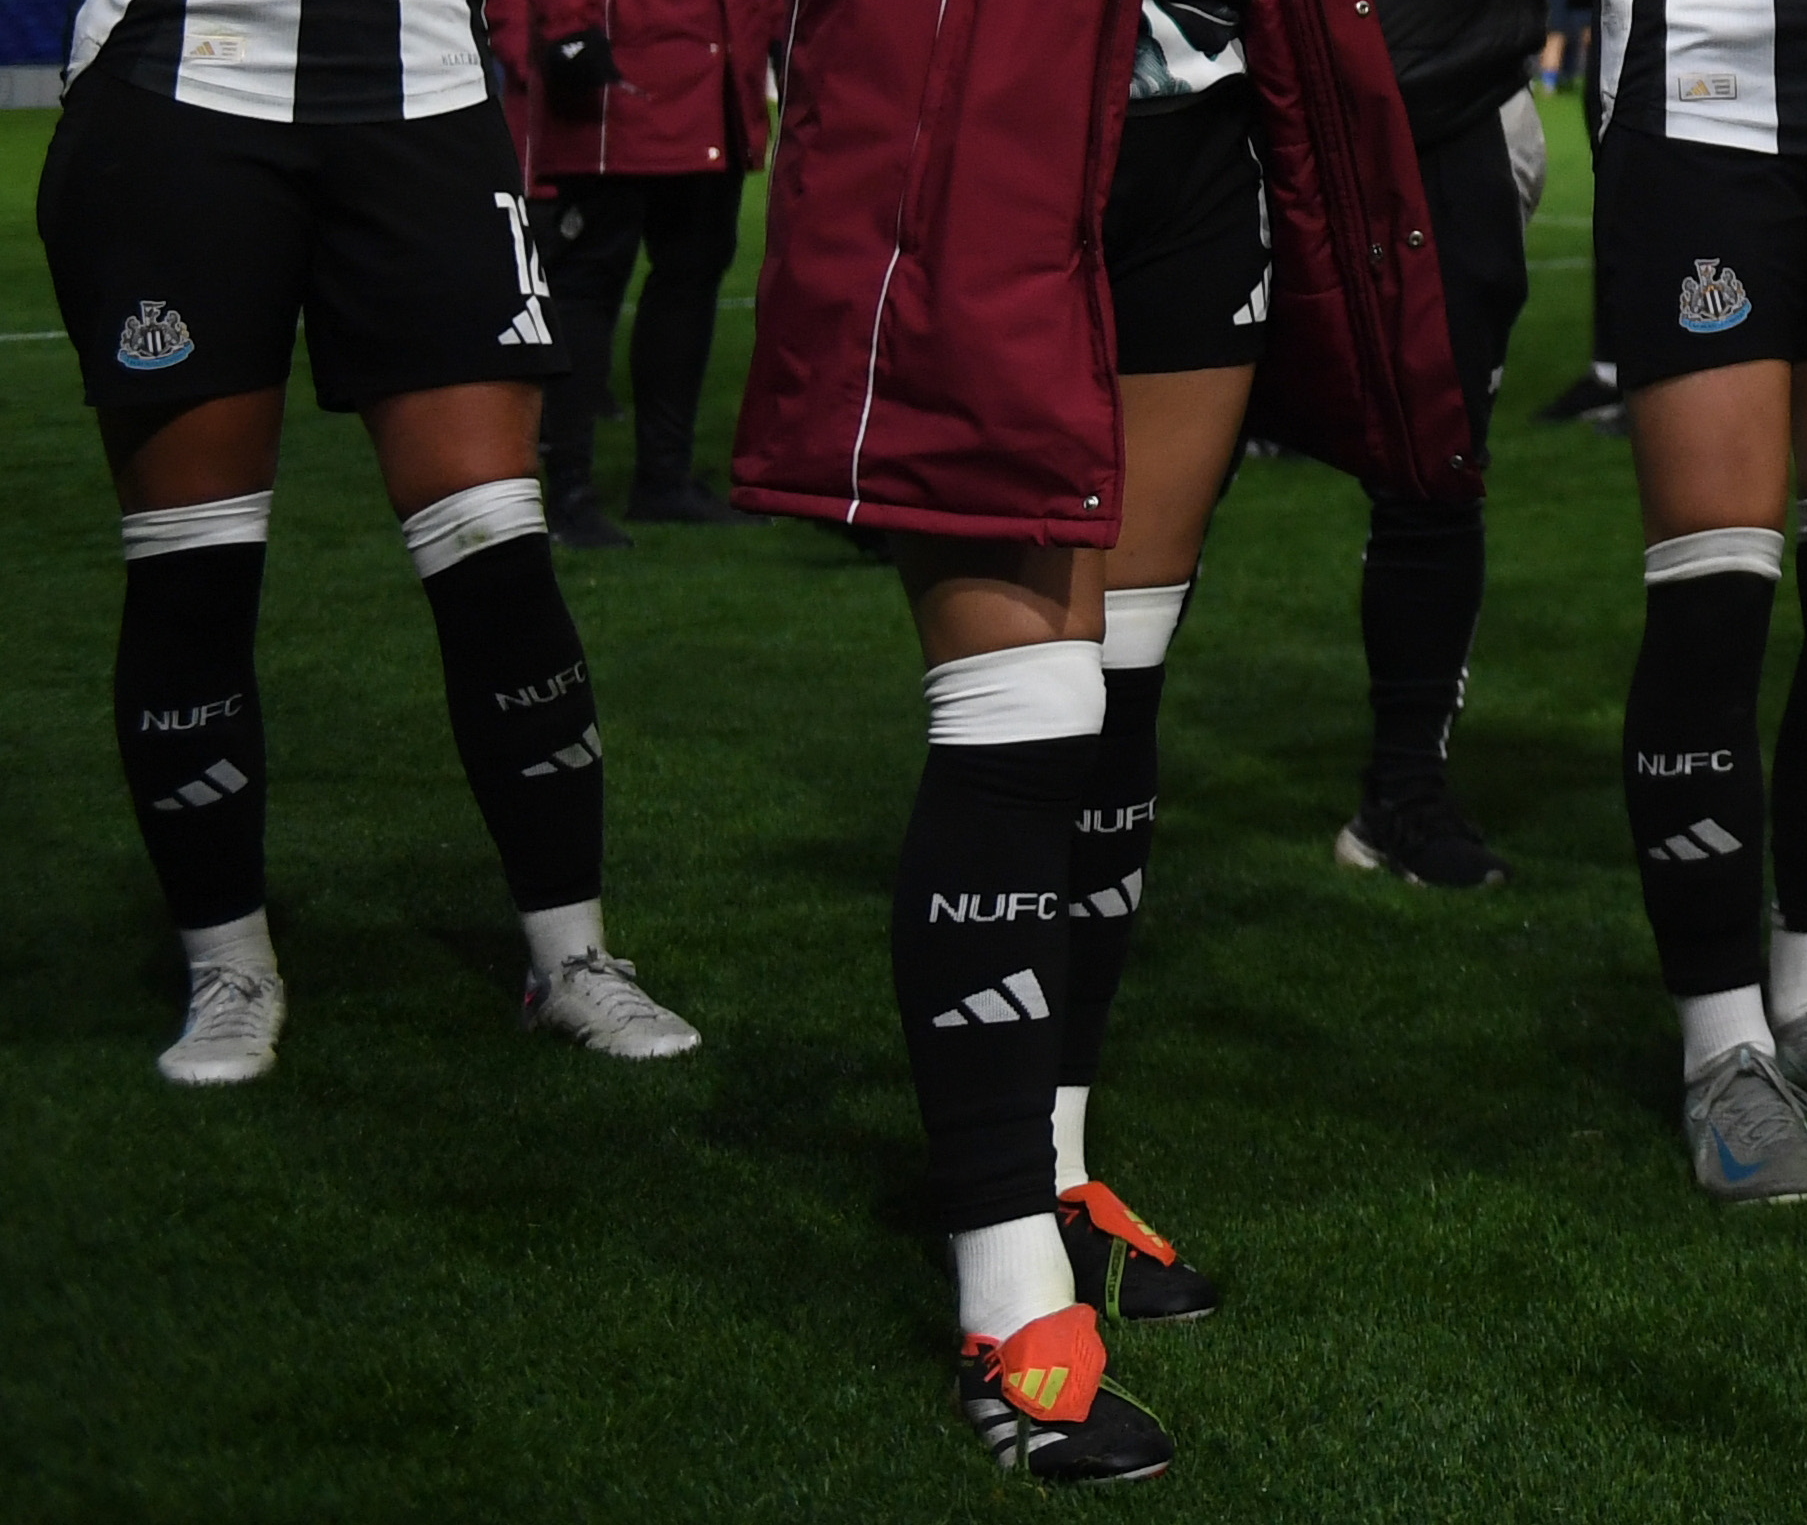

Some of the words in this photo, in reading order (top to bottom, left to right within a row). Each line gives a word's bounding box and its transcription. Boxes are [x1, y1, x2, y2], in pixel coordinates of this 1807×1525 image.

[141, 693, 244, 731] NUFC
[1637, 749, 1734, 776] NUFC
[929, 892, 1058, 924] NUFC
